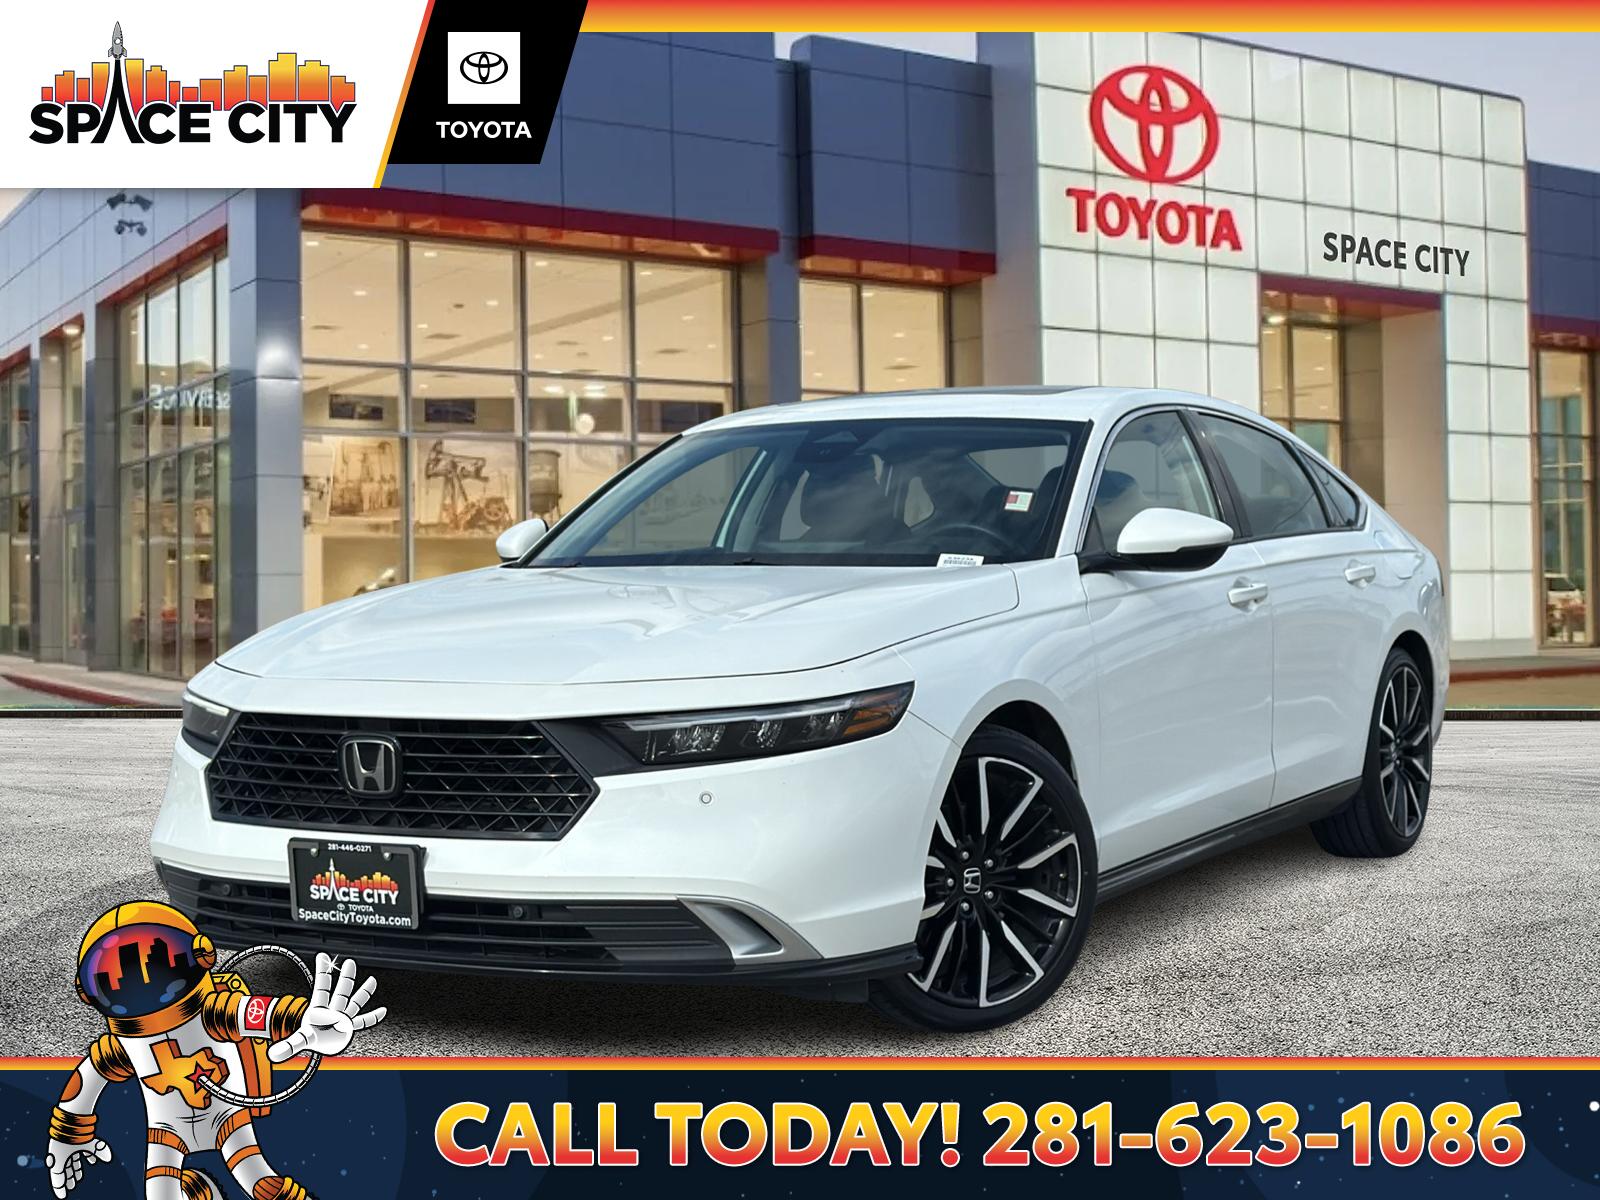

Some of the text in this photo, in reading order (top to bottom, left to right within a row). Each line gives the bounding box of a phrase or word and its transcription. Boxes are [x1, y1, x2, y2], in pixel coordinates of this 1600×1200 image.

[1066, 187, 1242, 252] TOYOTA
[1322, 232, 1471, 277] SPACE CITY
[309, 876, 399, 905] SPACE CITY
[298, 908, 412, 927] SpaceCityToyota.com
[348, 904, 374, 912] TOYOTA
